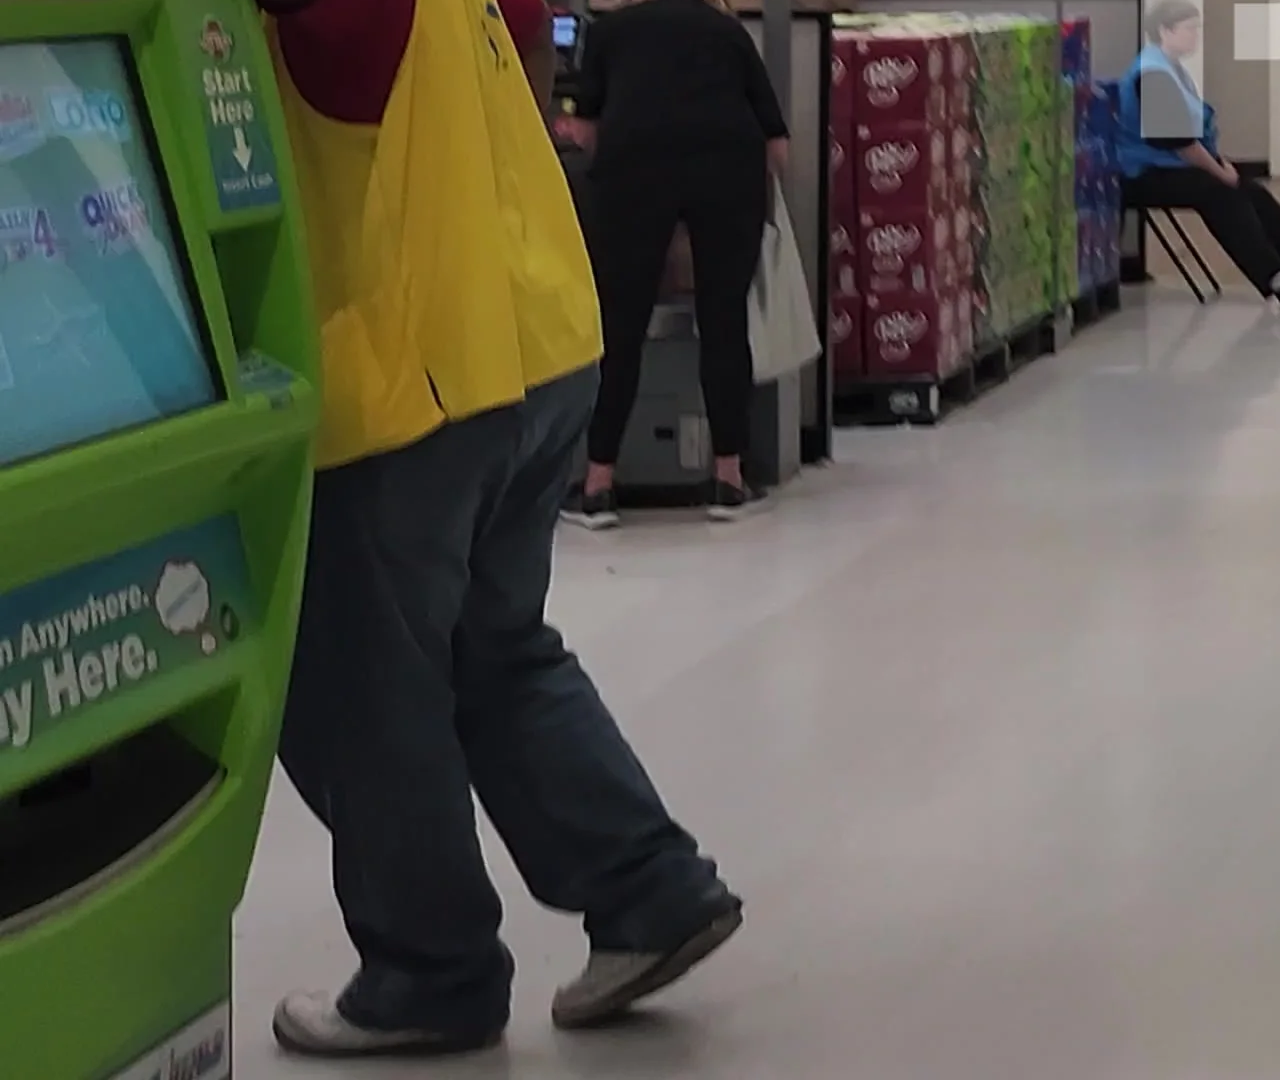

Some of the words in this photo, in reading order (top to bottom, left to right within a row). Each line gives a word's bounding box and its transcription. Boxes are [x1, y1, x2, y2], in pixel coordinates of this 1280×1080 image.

[202, 67, 251, 97] Start
[209, 98, 254, 126] Here
[20, 582, 150, 660] Anywhere.
[42, 632, 158, 717] Here.
